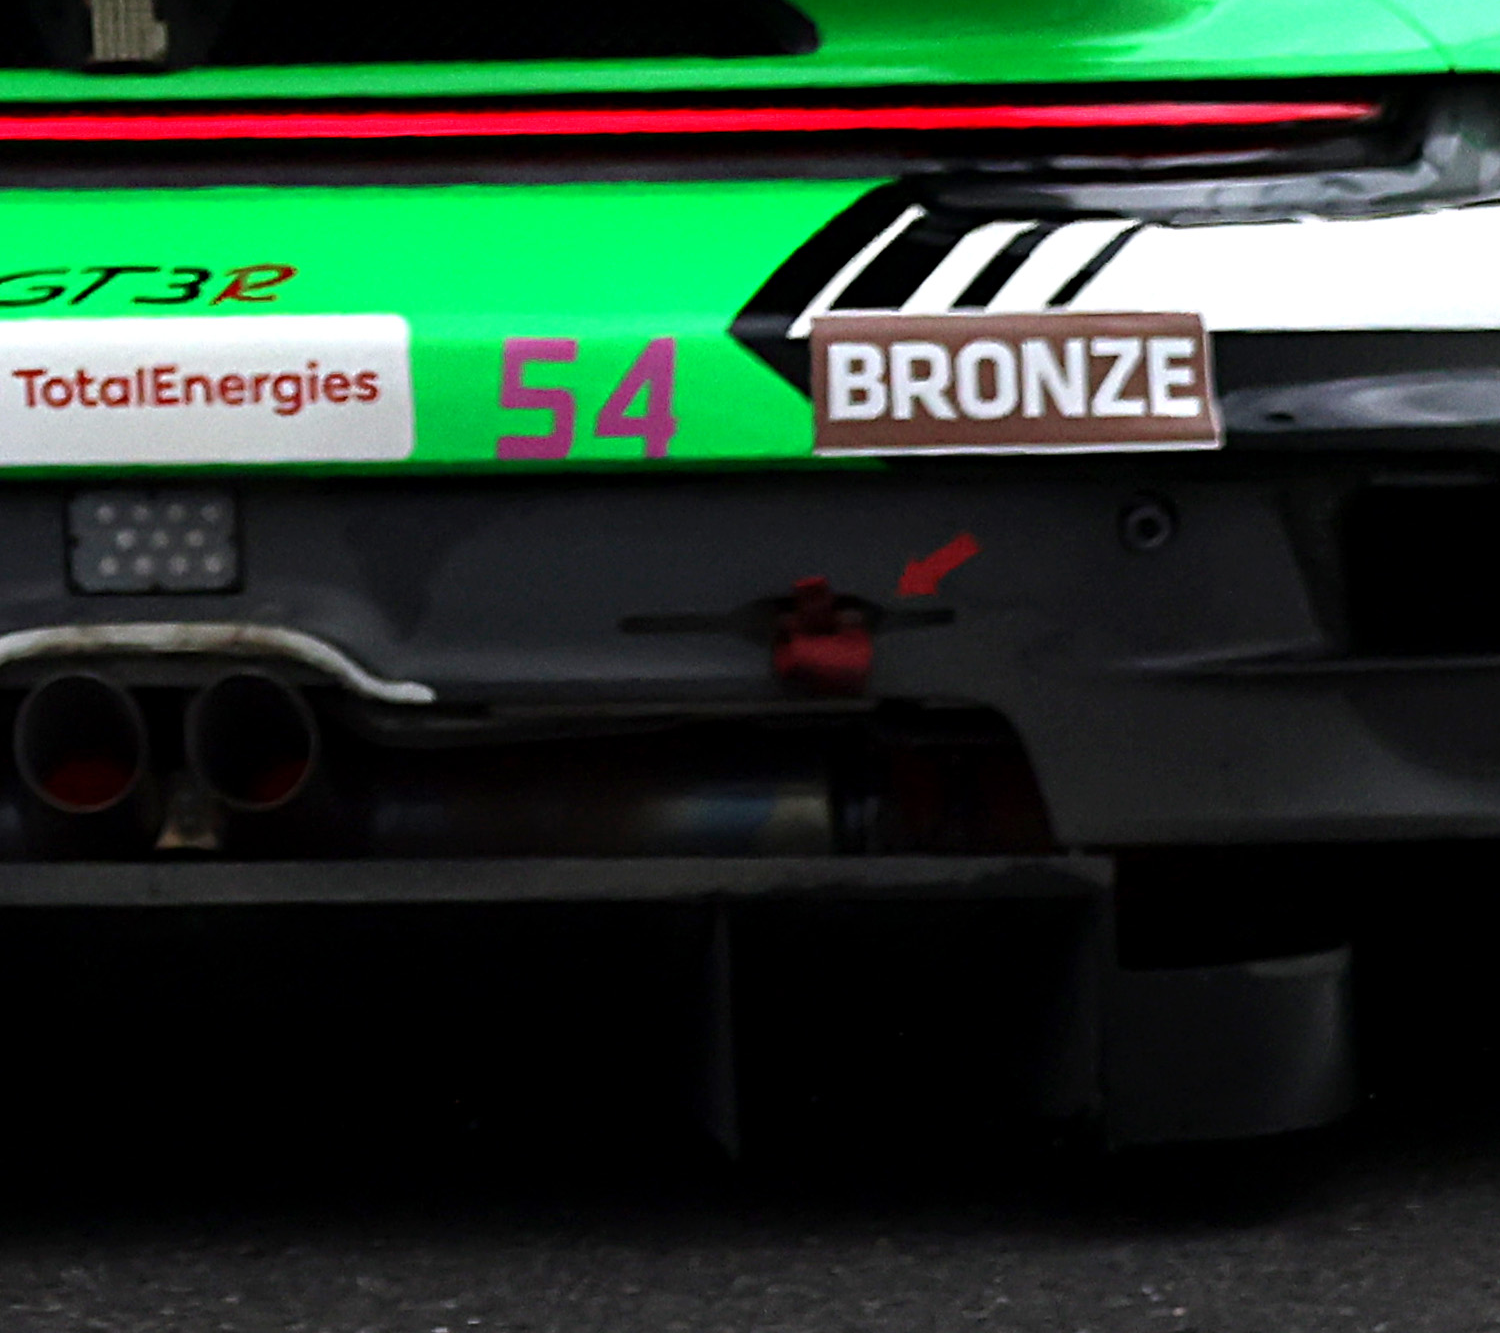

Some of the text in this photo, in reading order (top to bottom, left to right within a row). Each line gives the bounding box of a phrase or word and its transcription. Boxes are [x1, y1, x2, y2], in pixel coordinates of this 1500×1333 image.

[12, 361, 380, 416] TotalEnergies
[495, 336, 677, 459] 54
[826, 336, 1200, 421] BRONZE
